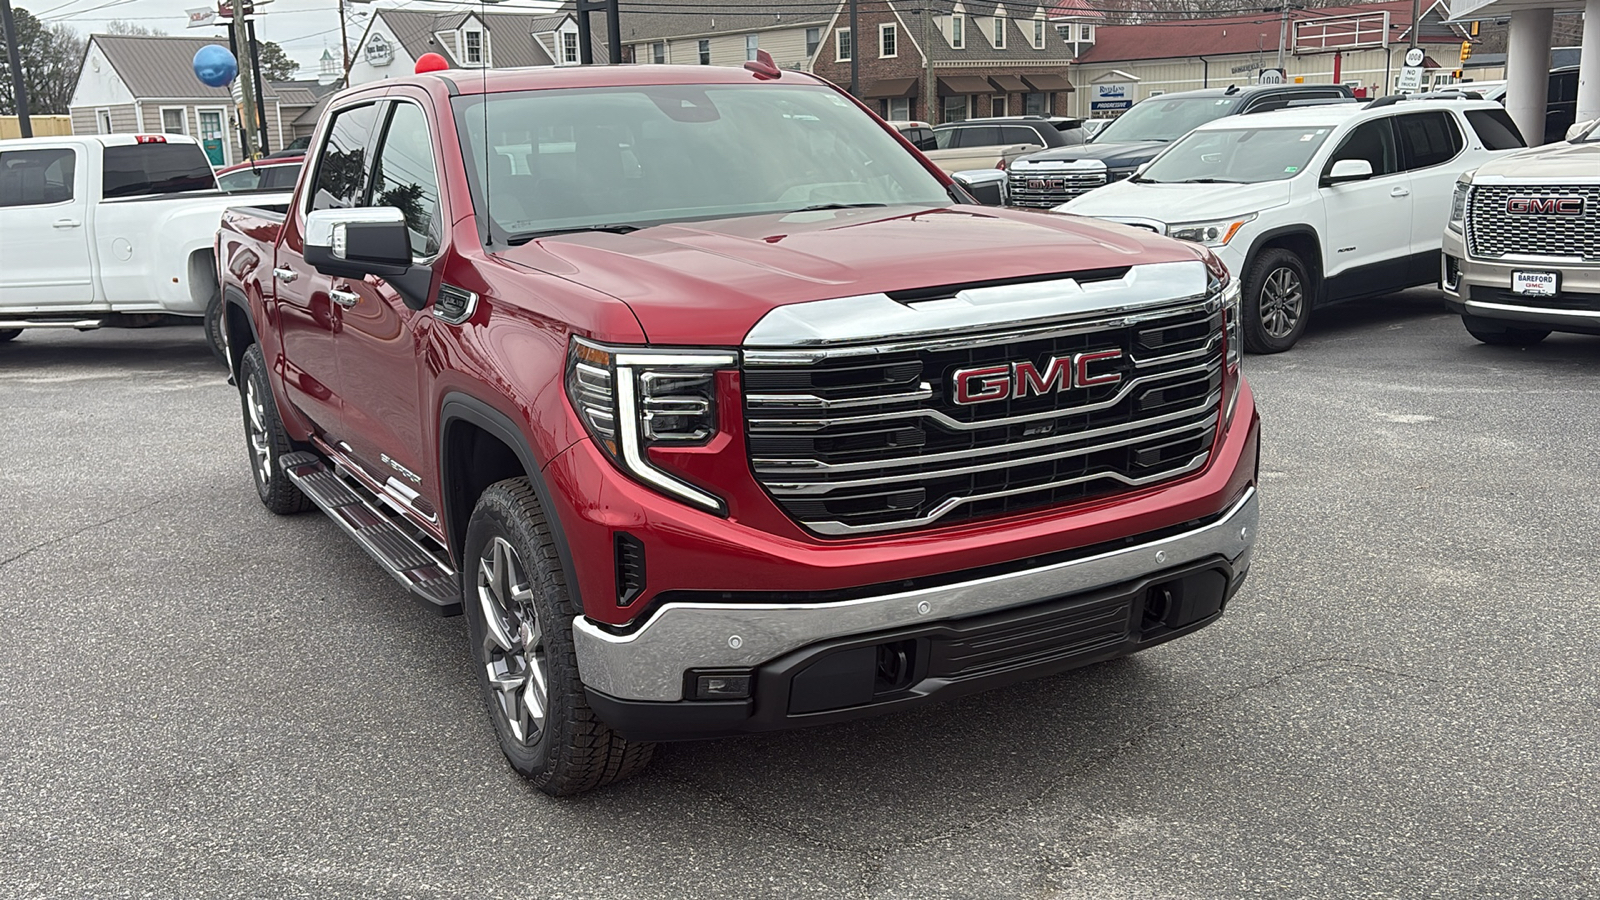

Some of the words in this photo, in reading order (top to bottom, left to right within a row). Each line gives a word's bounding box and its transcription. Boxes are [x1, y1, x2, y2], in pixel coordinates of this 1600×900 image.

[1408, 53, 1422, 61] 1008
[1263, 76, 1279, 84] 1010
[1028, 179, 1063, 189] GMC
[1508, 199, 1581, 213] GMC
[1518, 275, 1552, 283] BAREFORD
[953, 348, 1122, 405] GMC
